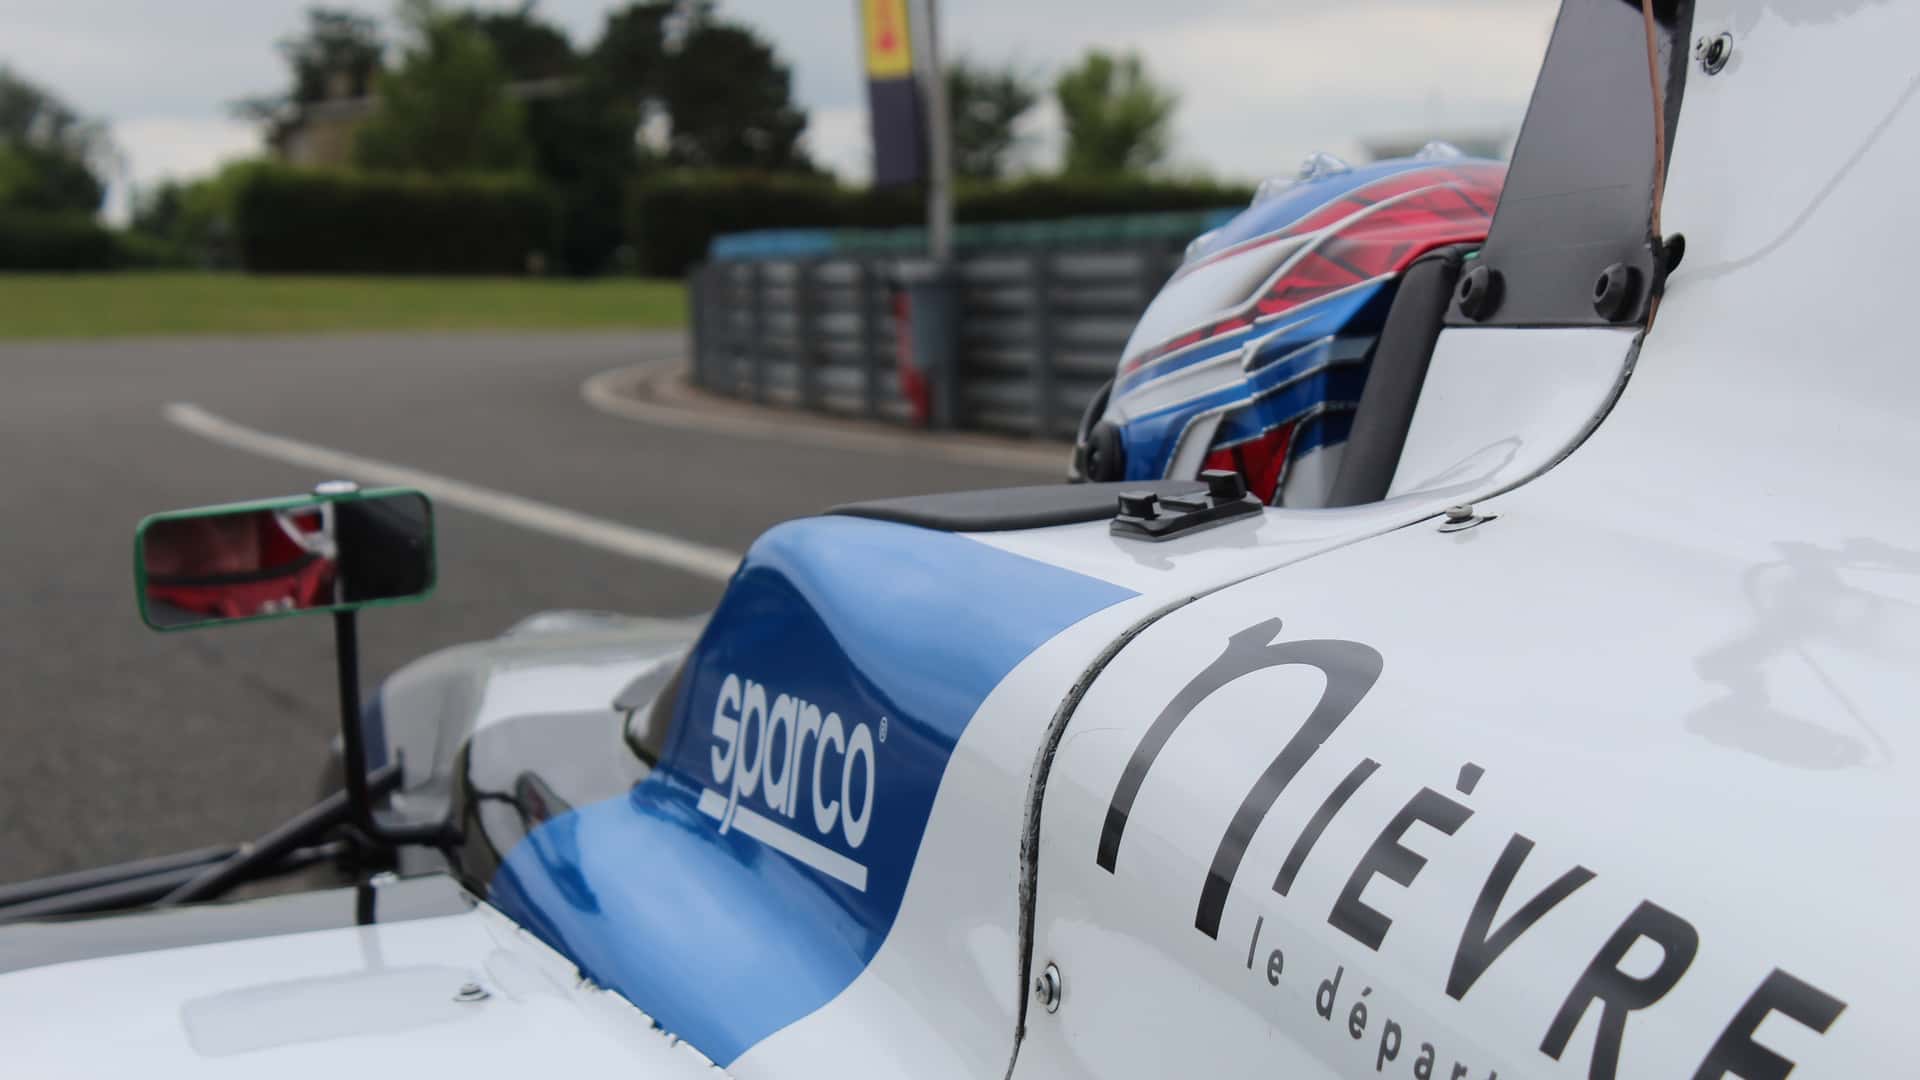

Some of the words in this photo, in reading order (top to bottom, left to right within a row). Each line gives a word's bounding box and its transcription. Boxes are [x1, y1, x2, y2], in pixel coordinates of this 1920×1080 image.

[711, 673, 875, 848] sparco
[1247, 916, 1284, 986] le
[1316, 966, 1498, 1080] dépar
